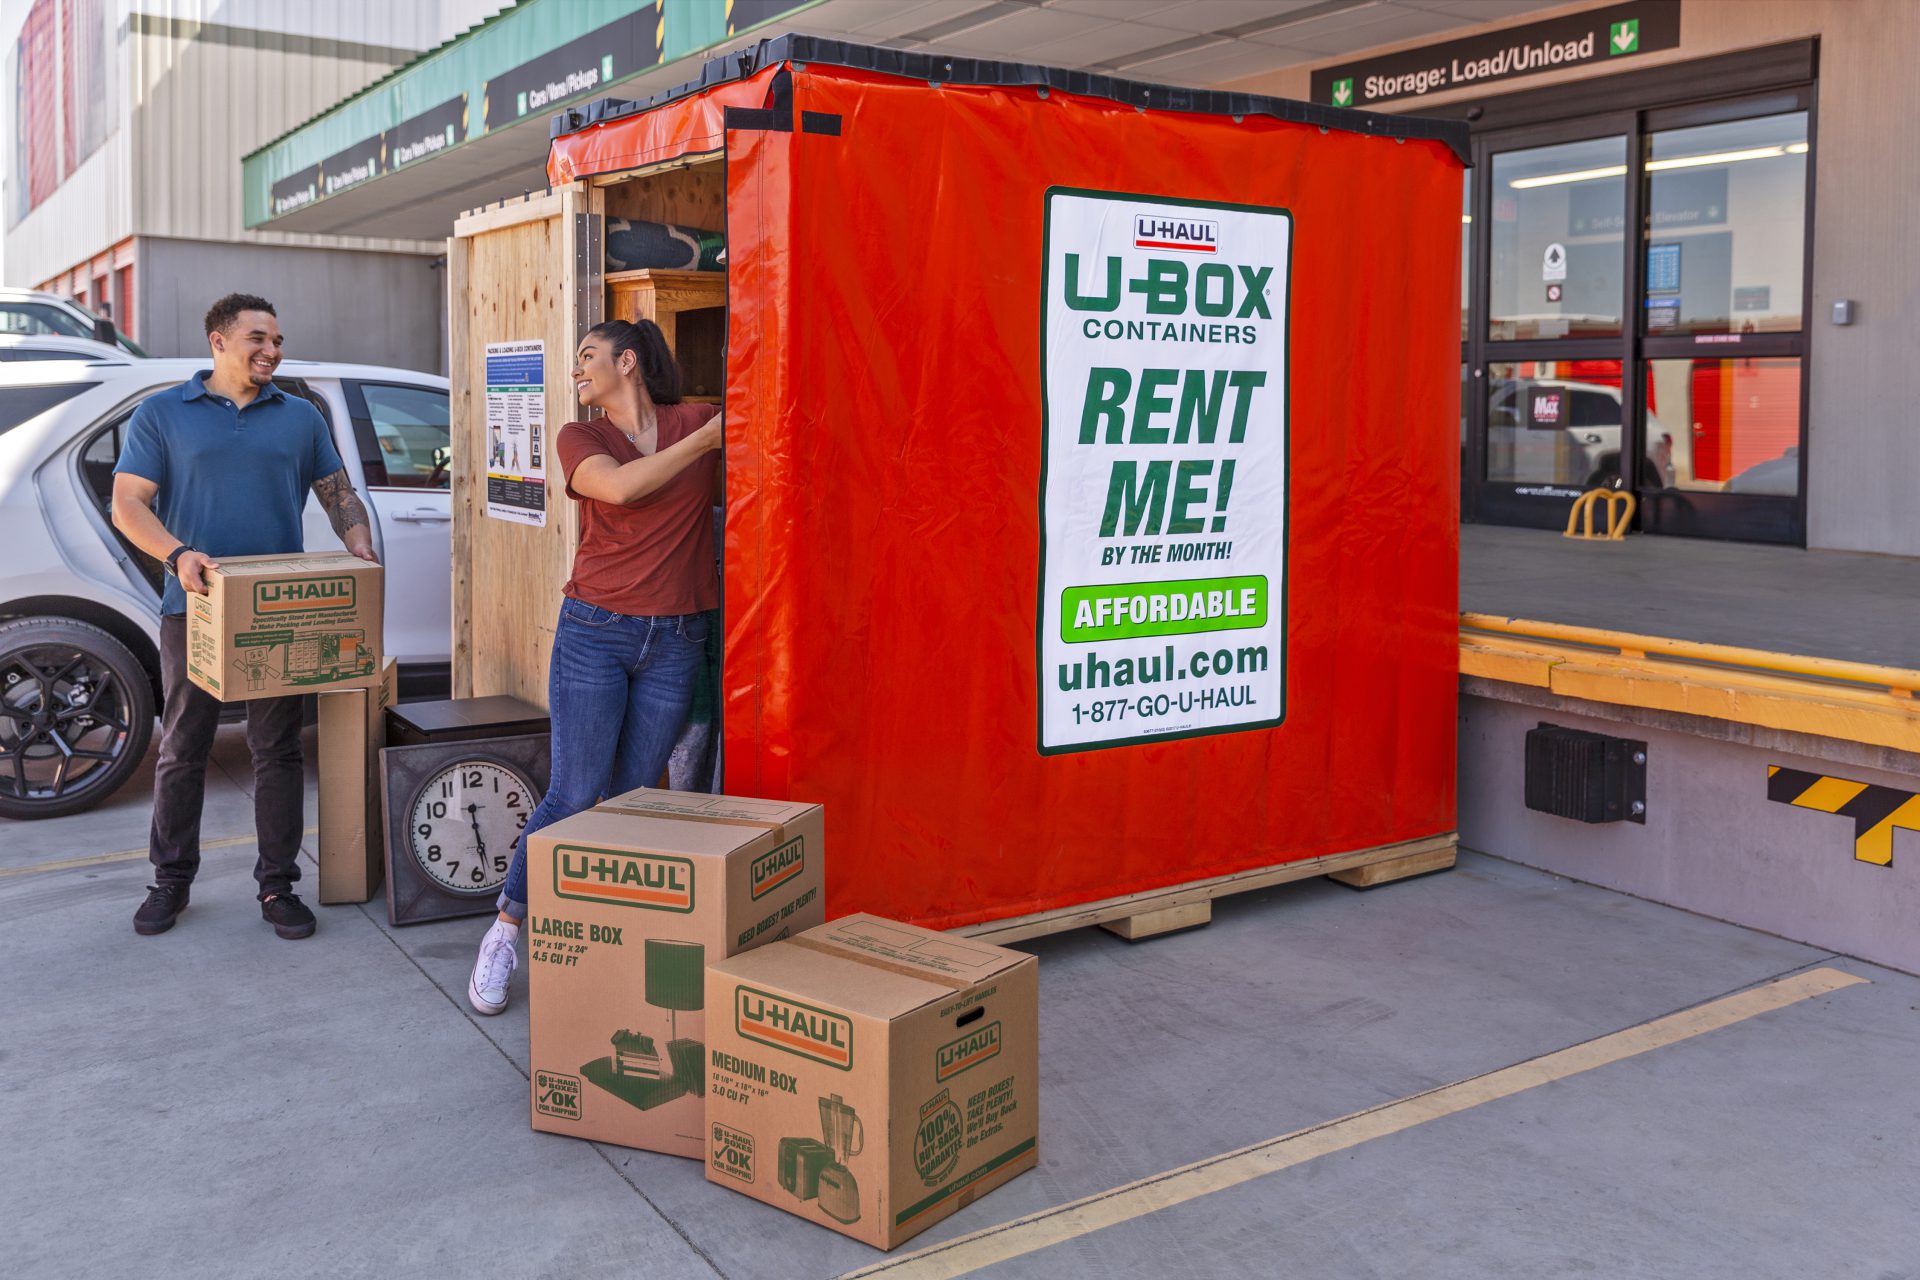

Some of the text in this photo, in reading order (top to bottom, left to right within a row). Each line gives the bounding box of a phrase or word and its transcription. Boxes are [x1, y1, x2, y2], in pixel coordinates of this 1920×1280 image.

[1365, 32, 1594, 98] Storage: Load/Unload
[1138, 219, 1216, 242] U-HAUL
[1083, 319, 1257, 344] CONTAINERS
[1078, 367, 1267, 444] RENT
[1098, 459, 1236, 538] ME!
[1101, 542, 1232, 566] BY THE MONTH!
[261, 582, 349, 601] U-HAUL
[1074, 588, 1256, 629] AFFORDABLE
[1058, 645, 1268, 692] uhaul.com
[1072, 684, 1256, 724] 1-877-GO-U-HAUL
[442, 782, 454, 798] 11
[463, 771, 483, 788] 12
[494, 777, 498, 793] 1
[426, 802, 446, 819] 10
[506, 792, 520, 808] 2
[418, 824, 432, 840] 9
[516, 813, 528, 829] 3
[428, 845, 442, 862] 8
[494, 856, 508, 872] 5
[755, 844, 800, 883] U-HAUL
[447, 861, 459, 878] 7
[471, 867, 484, 882] 6
[563, 854, 685, 891] U-HAUL
[738, 926, 755, 947] NEED
[757, 911, 780, 935] BOXES?
[781, 902, 794, 920] TAKE
[796, 887, 816, 910] PLENTY!
[532, 916, 623, 945] LARGE BOX
[533, 951, 578, 966] 4.5 CU FT
[744, 995, 845, 1048] U-HAUL
[940, 1028, 997, 1067] U-HAUL
[549, 1077, 578, 1087] U-HAUL
[712, 1050, 798, 1094] MEDIUM BOX
[549, 1083, 578, 1094] BOXES
[712, 1084, 750, 1105] 3.0 CU FT
[967, 1076, 1014, 1108] NEED BOXES?
[539, 1104, 578, 1117] FOR SHIPPING
[552, 1092, 577, 1109] OK
[922, 1093, 947, 1114] U-HAUL
[967, 1090, 1013, 1121] TAKE PLENTY!
[920, 1108, 955, 1147] 100%
[967, 1100, 1017, 1134] We'll Buy Back
[724, 1130, 752, 1146] U-HAUL
[724, 1138, 752, 1153] BOXES
[919, 1123, 960, 1165] BUY-BACK
[967, 1136, 978, 1148] the
[713, 1160, 752, 1180] FOR SHIPPING
[727, 1148, 751, 1171] OK
[920, 1140, 962, 1180] GUARANTEE
